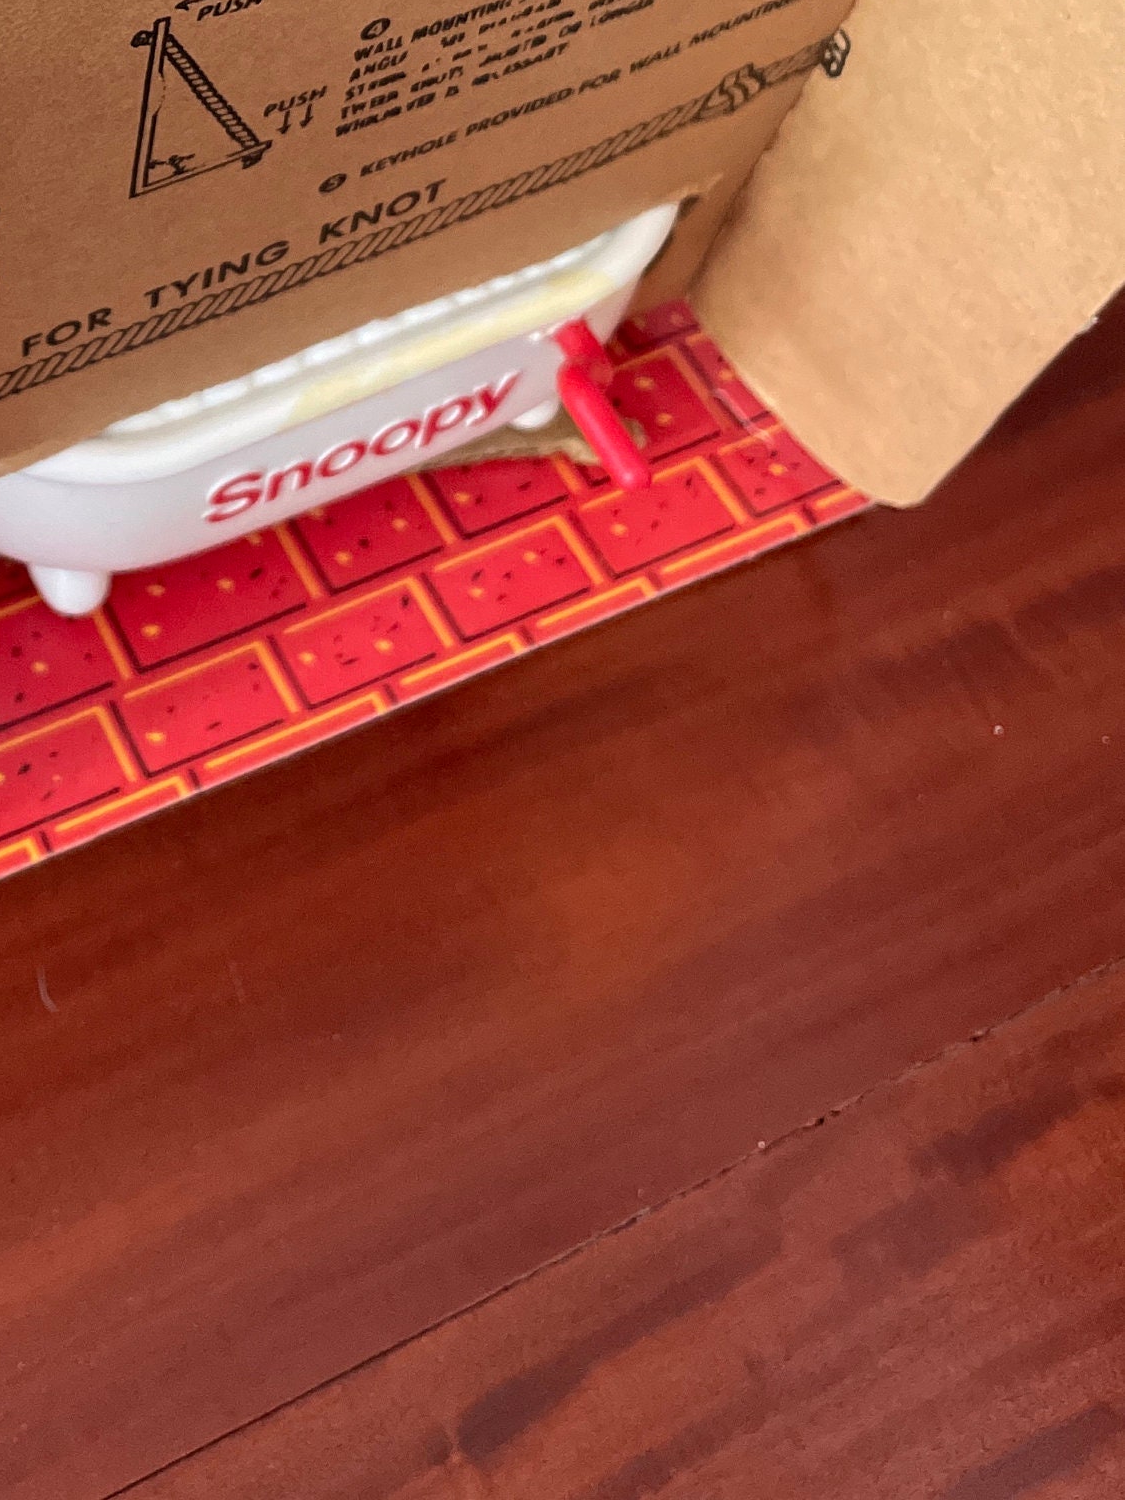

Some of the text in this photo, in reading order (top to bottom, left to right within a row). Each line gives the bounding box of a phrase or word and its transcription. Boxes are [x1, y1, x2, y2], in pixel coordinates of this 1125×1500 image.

[263, 85, 327, 117] PUSH
[354, 36, 403, 61] WALL
[360, 129, 458, 177] KEYHOLE
[465, 87, 574, 137] PROVIDED
[630, 41, 681, 75] WALL
[20, 307, 113, 357] FOR
[143, 239, 291, 309] TYING
[318, 177, 448, 246] KNOT
[204, 369, 522, 523] Snoopy
